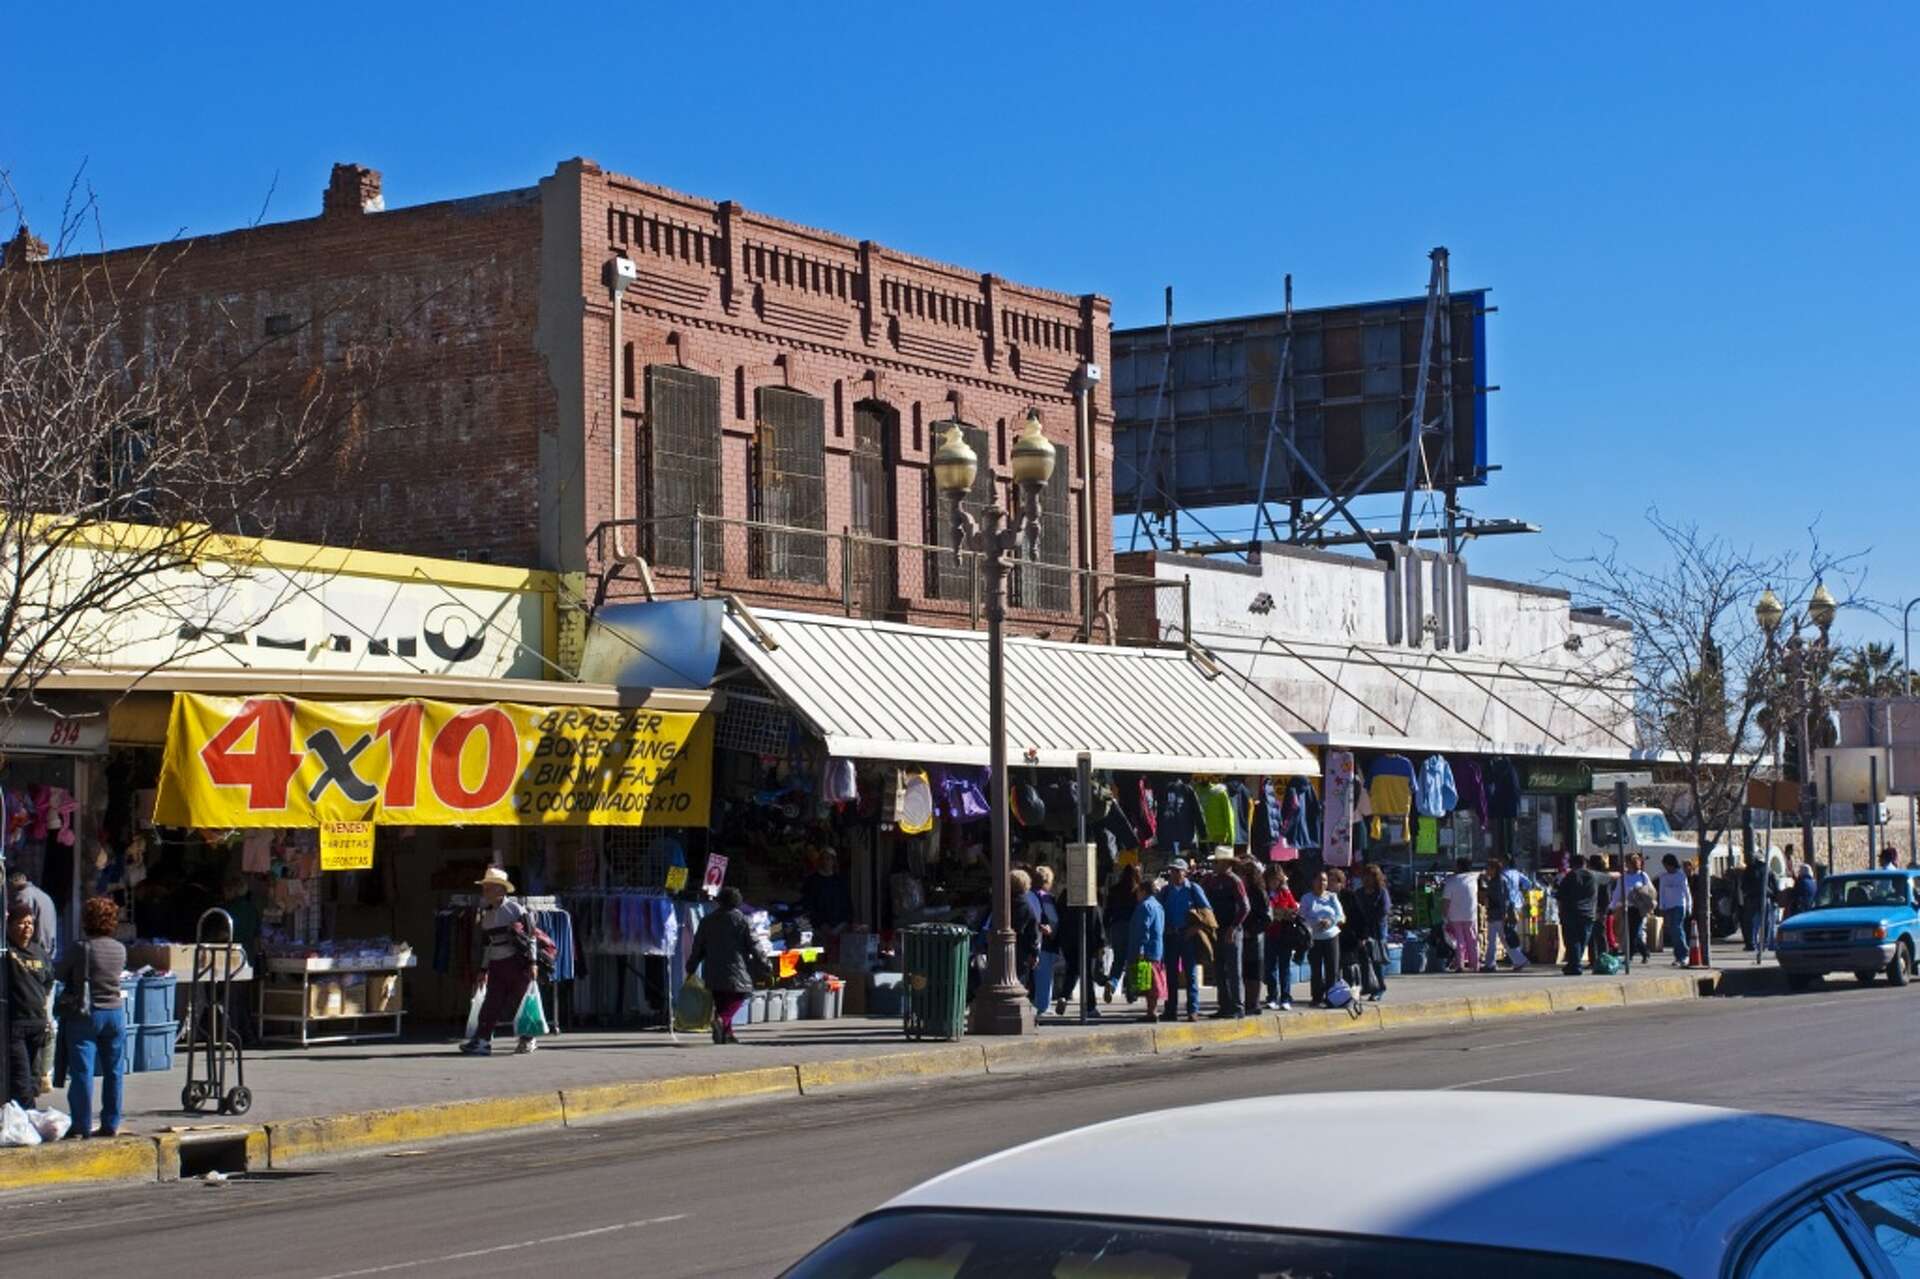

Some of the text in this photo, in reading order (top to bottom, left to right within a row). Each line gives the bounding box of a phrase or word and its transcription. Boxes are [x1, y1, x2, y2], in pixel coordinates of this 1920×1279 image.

[49, 718, 80, 745] 814
[537, 710, 663, 734] BRASSIER
[534, 735, 690, 761] BOXER TANGA
[614, 766, 679, 787] FAJA
[518, 791, 532, 814] 2
